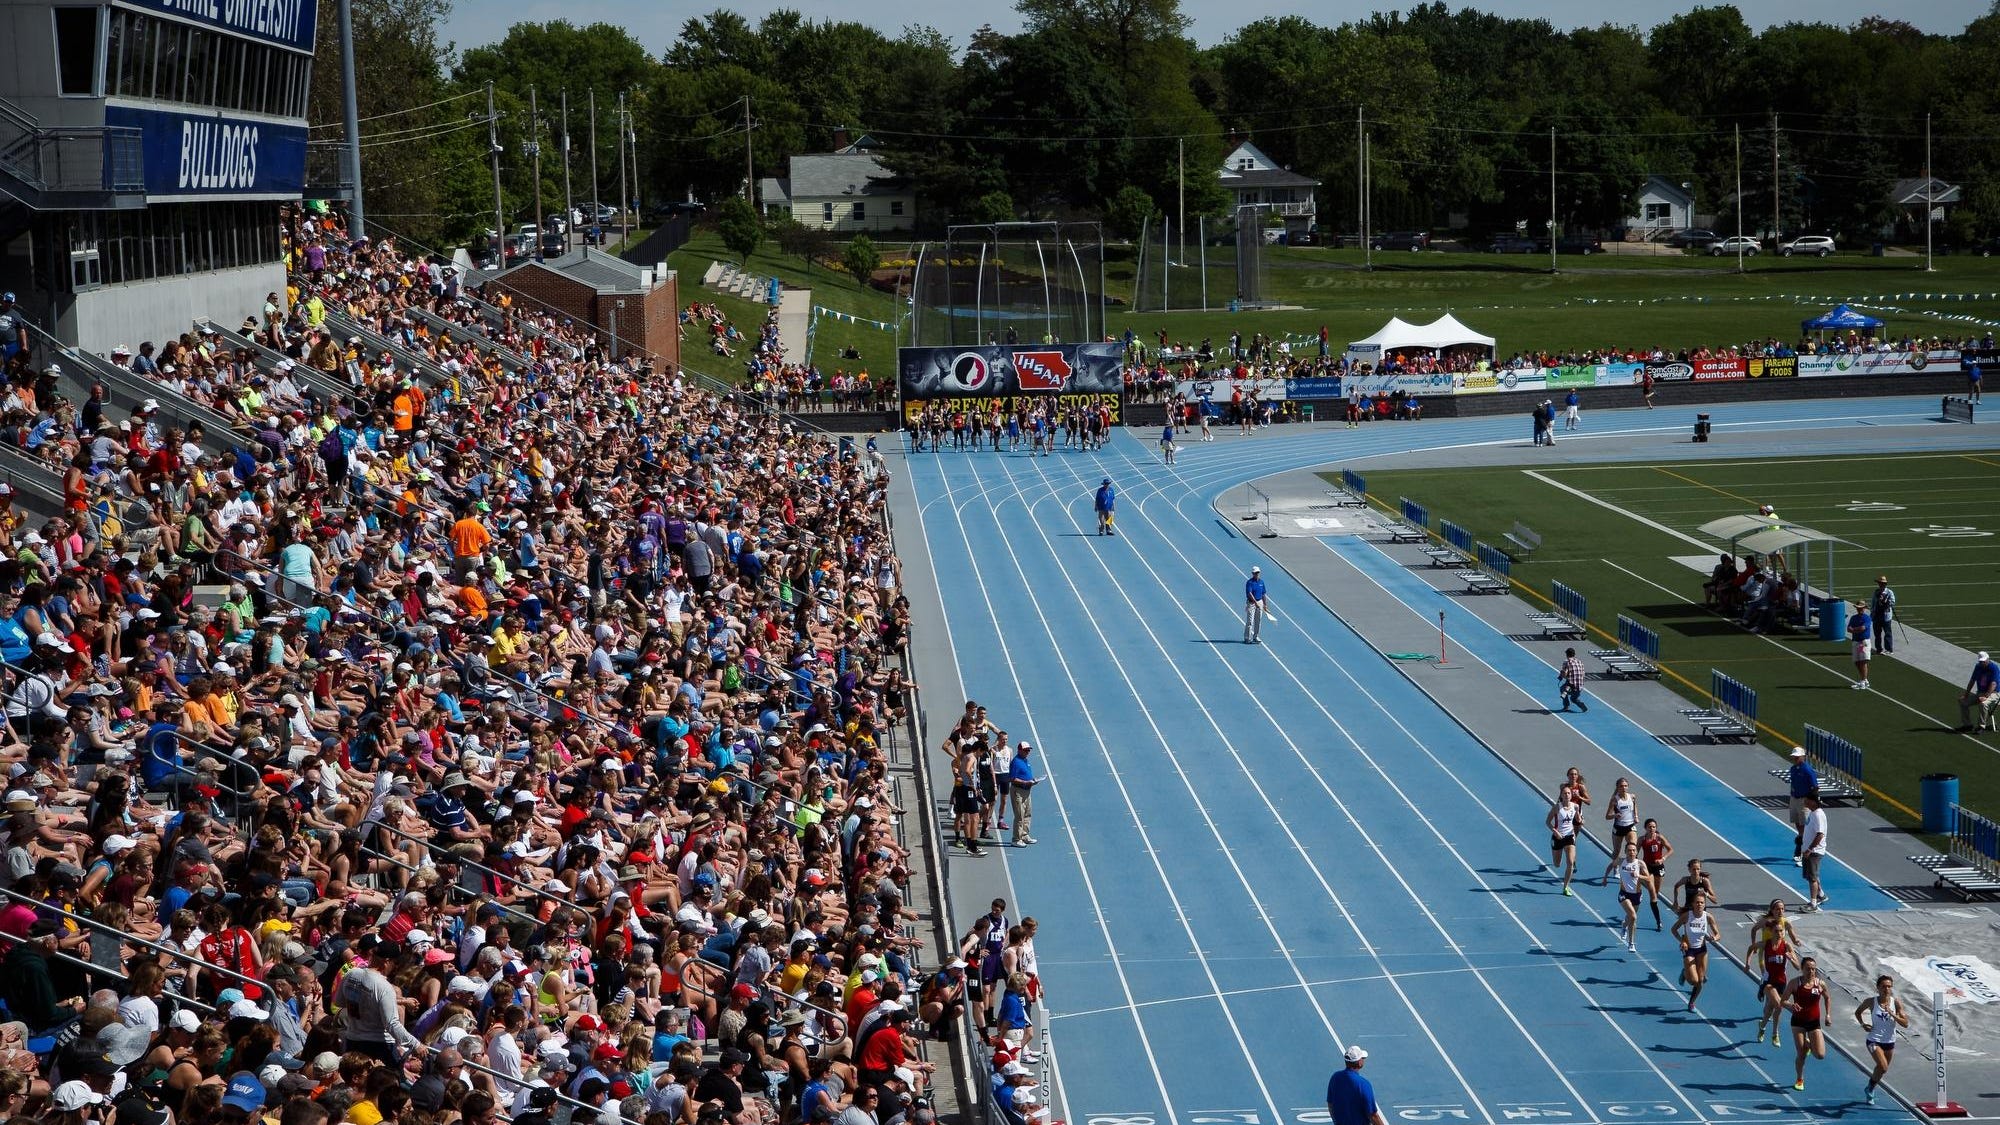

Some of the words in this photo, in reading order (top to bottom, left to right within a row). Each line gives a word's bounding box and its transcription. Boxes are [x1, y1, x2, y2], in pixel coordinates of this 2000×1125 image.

[179, 120, 259, 189] BULLDOGS
[1702, 361, 1738, 370] conduct
[1764, 358, 1796, 368] FAREWAY
[1799, 360, 1833, 369] Channel
[1018, 354, 1061, 385] IHSAA
[1695, 370, 1745, 380] counts.com
[1769, 367, 1793, 377] FOODS
[931, 397, 1009, 414] FREWY
[1935, 1010, 1946, 1093] FINISH
[1041, 1029, 1051, 1109] FINISH
[1399, 1109, 1471, 1120] 5
[1502, 1106, 1573, 1119] 4
[1607, 1105, 1678, 1117] 3
[1087, 1116, 1156, 1125] 8
[1191, 1113, 1261, 1125] 7
